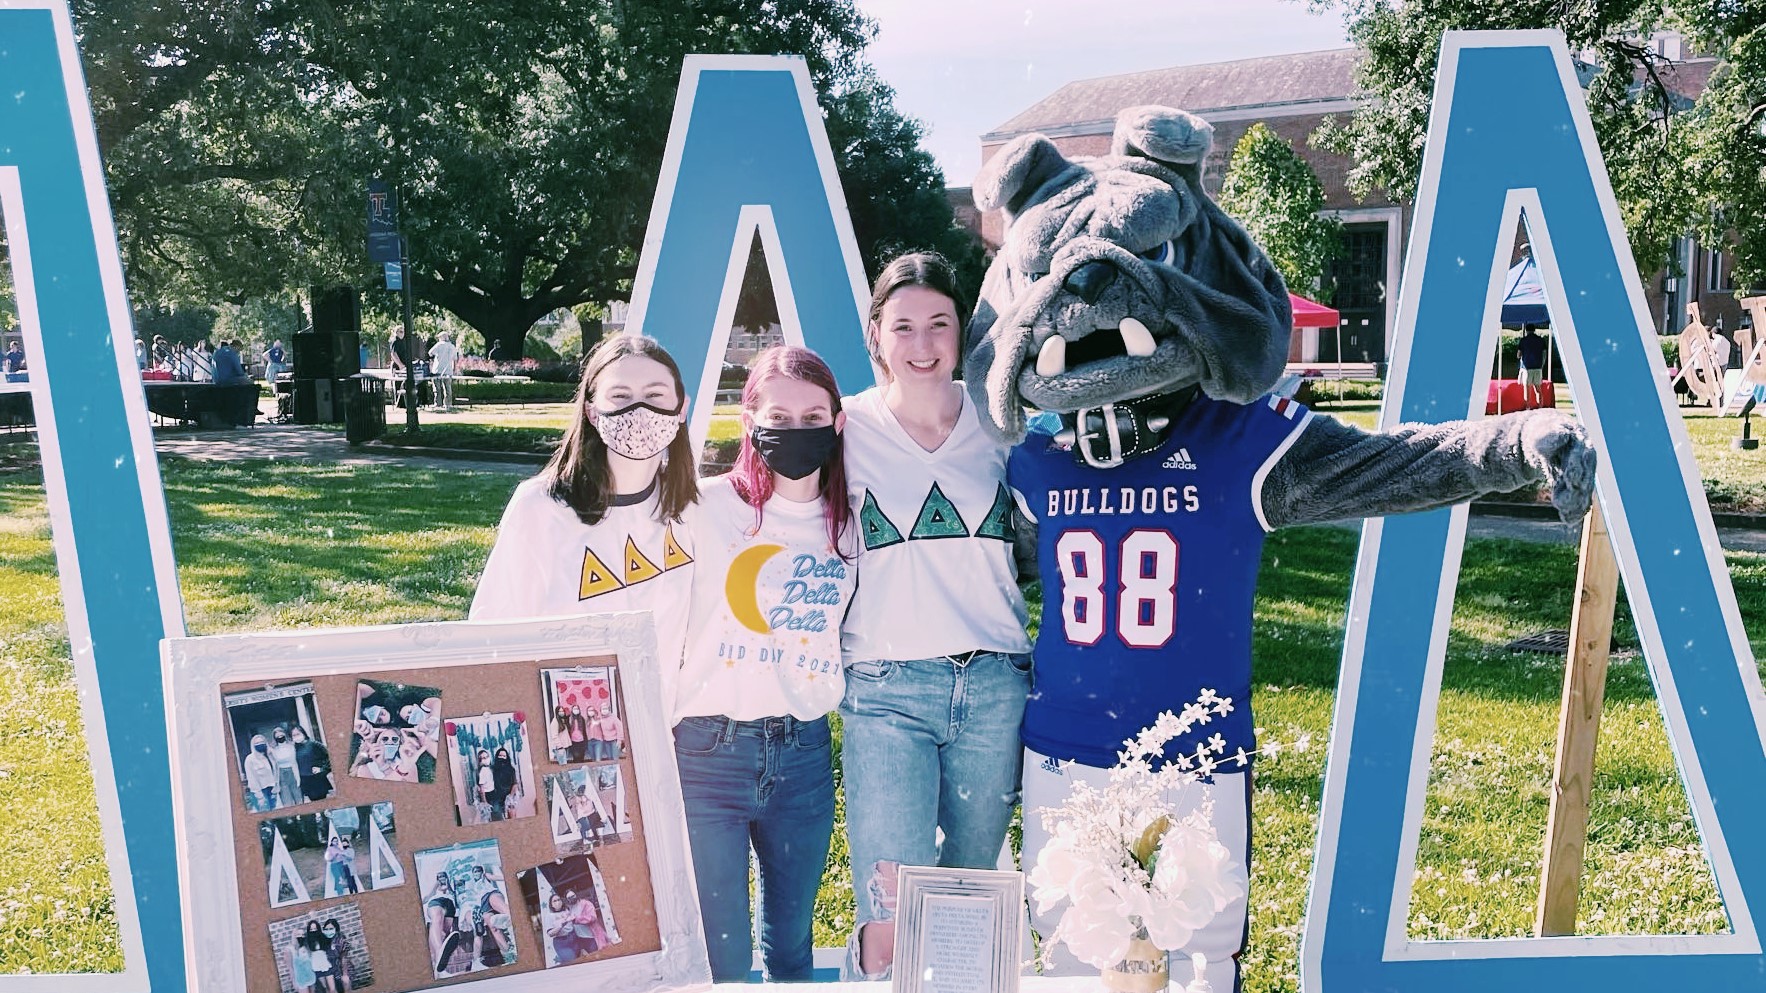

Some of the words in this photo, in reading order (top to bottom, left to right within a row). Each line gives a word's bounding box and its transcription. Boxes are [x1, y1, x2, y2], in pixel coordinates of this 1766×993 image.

[1162, 460, 1197, 470] adidas
[1047, 485, 1200, 517] BULLDOGS
[792, 553, 847, 580] Delta
[780, 579, 841, 605] Delta
[1055, 528, 1180, 649] 88
[769, 605, 829, 633] Delta
[718, 642, 747, 660] BID
[1041, 763, 1063, 775] adidas
